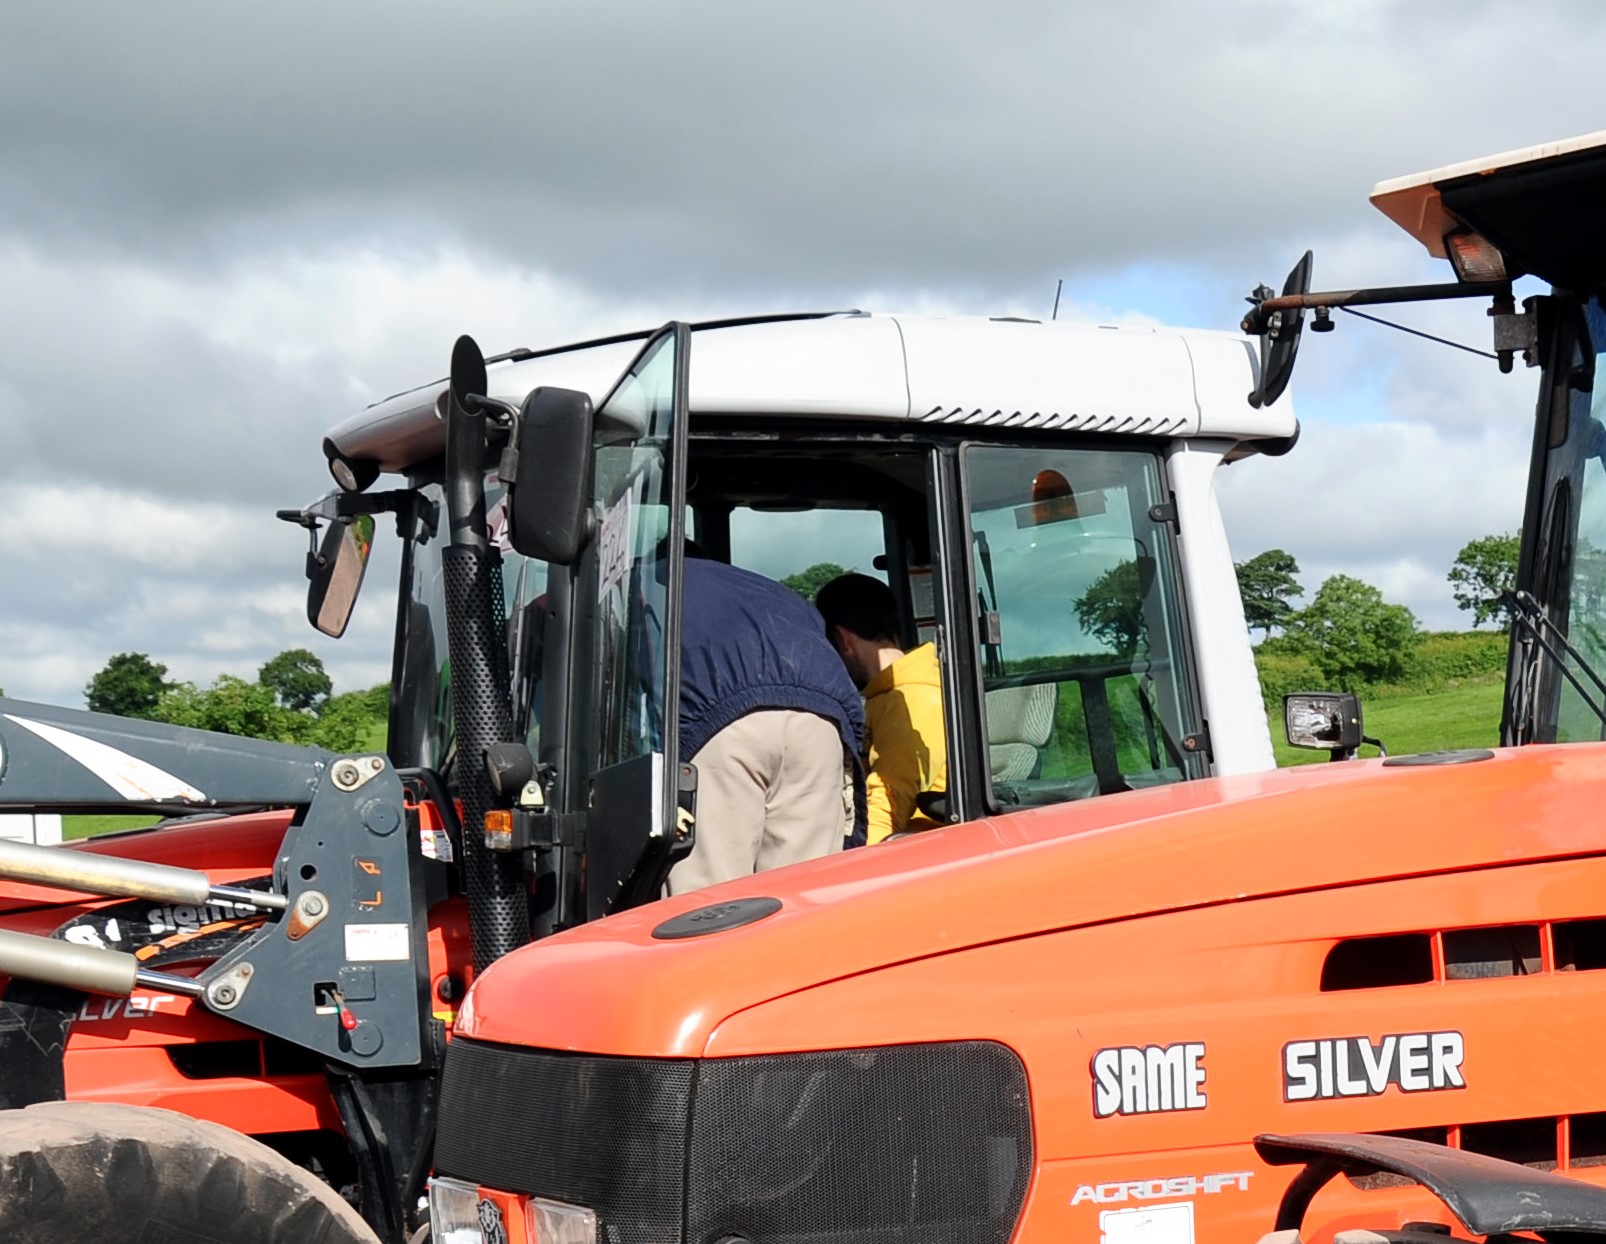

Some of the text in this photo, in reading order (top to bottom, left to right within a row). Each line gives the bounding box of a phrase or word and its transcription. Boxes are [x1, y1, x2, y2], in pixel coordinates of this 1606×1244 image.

[1092, 1031, 1465, 1118] SAME SILVER
[1070, 1171, 1255, 1206] AGROSHIFT
